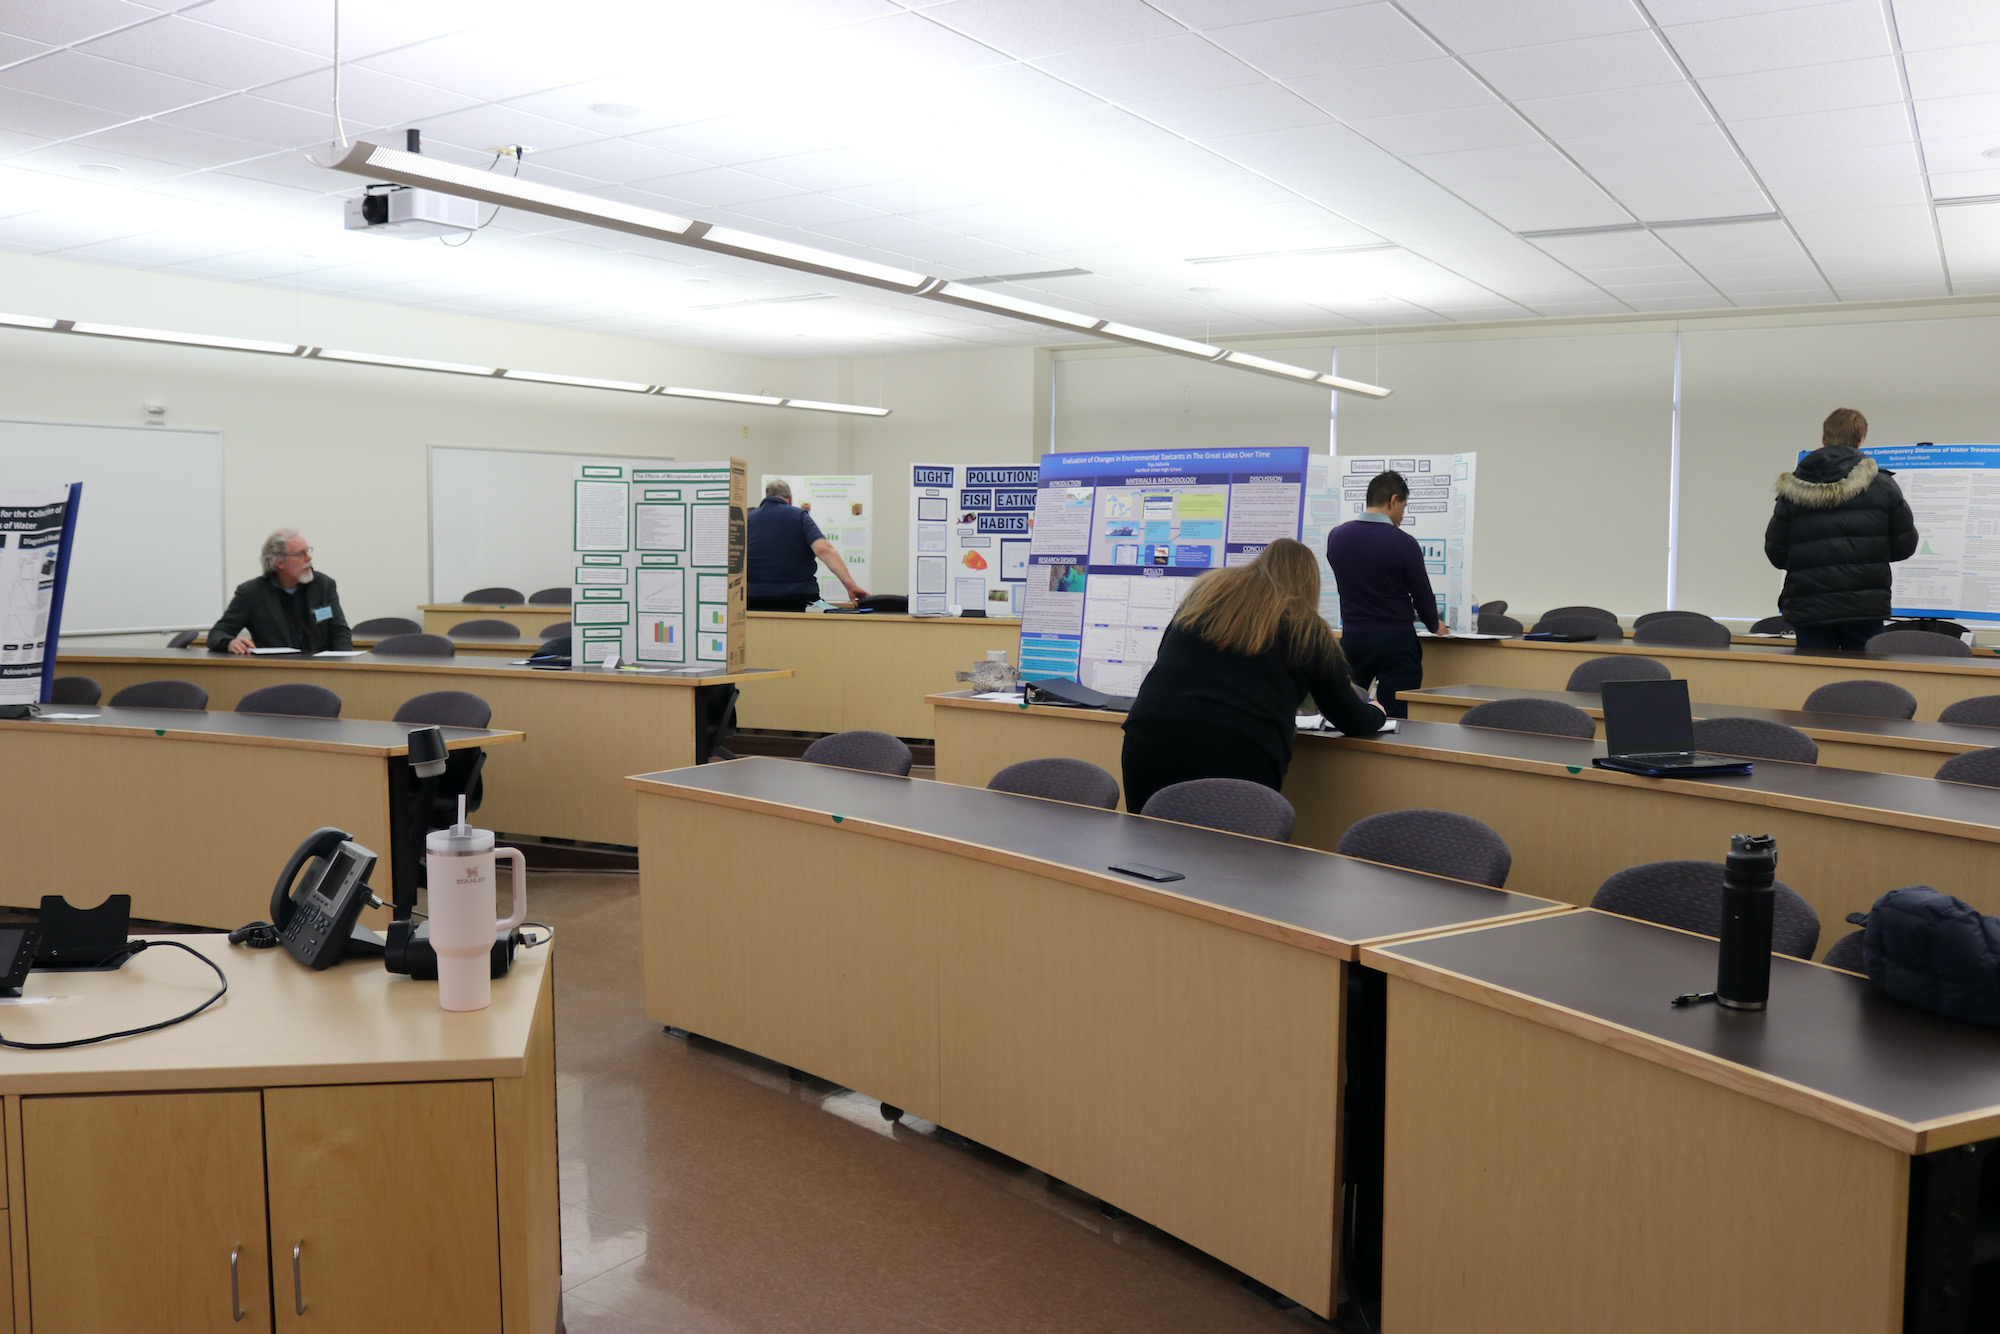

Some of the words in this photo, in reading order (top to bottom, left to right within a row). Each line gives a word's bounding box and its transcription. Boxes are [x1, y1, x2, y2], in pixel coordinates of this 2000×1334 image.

[1062, 457, 1087, 465] Evaluation
[1094, 455, 1115, 463] Changes
[1122, 454, 1160, 462] Environmental
[1161, 453, 1185, 461] Toxicants
[1205, 451, 1221, 459] Great
[1239, 450, 1254, 458] Over
[703, 472, 724, 480] Marigold
[917, 471, 950, 483] LIGHT
[969, 471, 1037, 483] POLLUTION:
[1049, 480, 1082, 488] INTRODUCTION
[963, 494, 989, 505] FISH
[1, 510, 12, 518] for
[13, 510, 27, 518] the
[55, 505, 62, 514] of
[1410, 504, 1445, 512] Waterways
[4, 521, 12, 529] of
[980, 517, 1024, 529] HABITS
[1243, 545, 1266, 553] CONCLU
